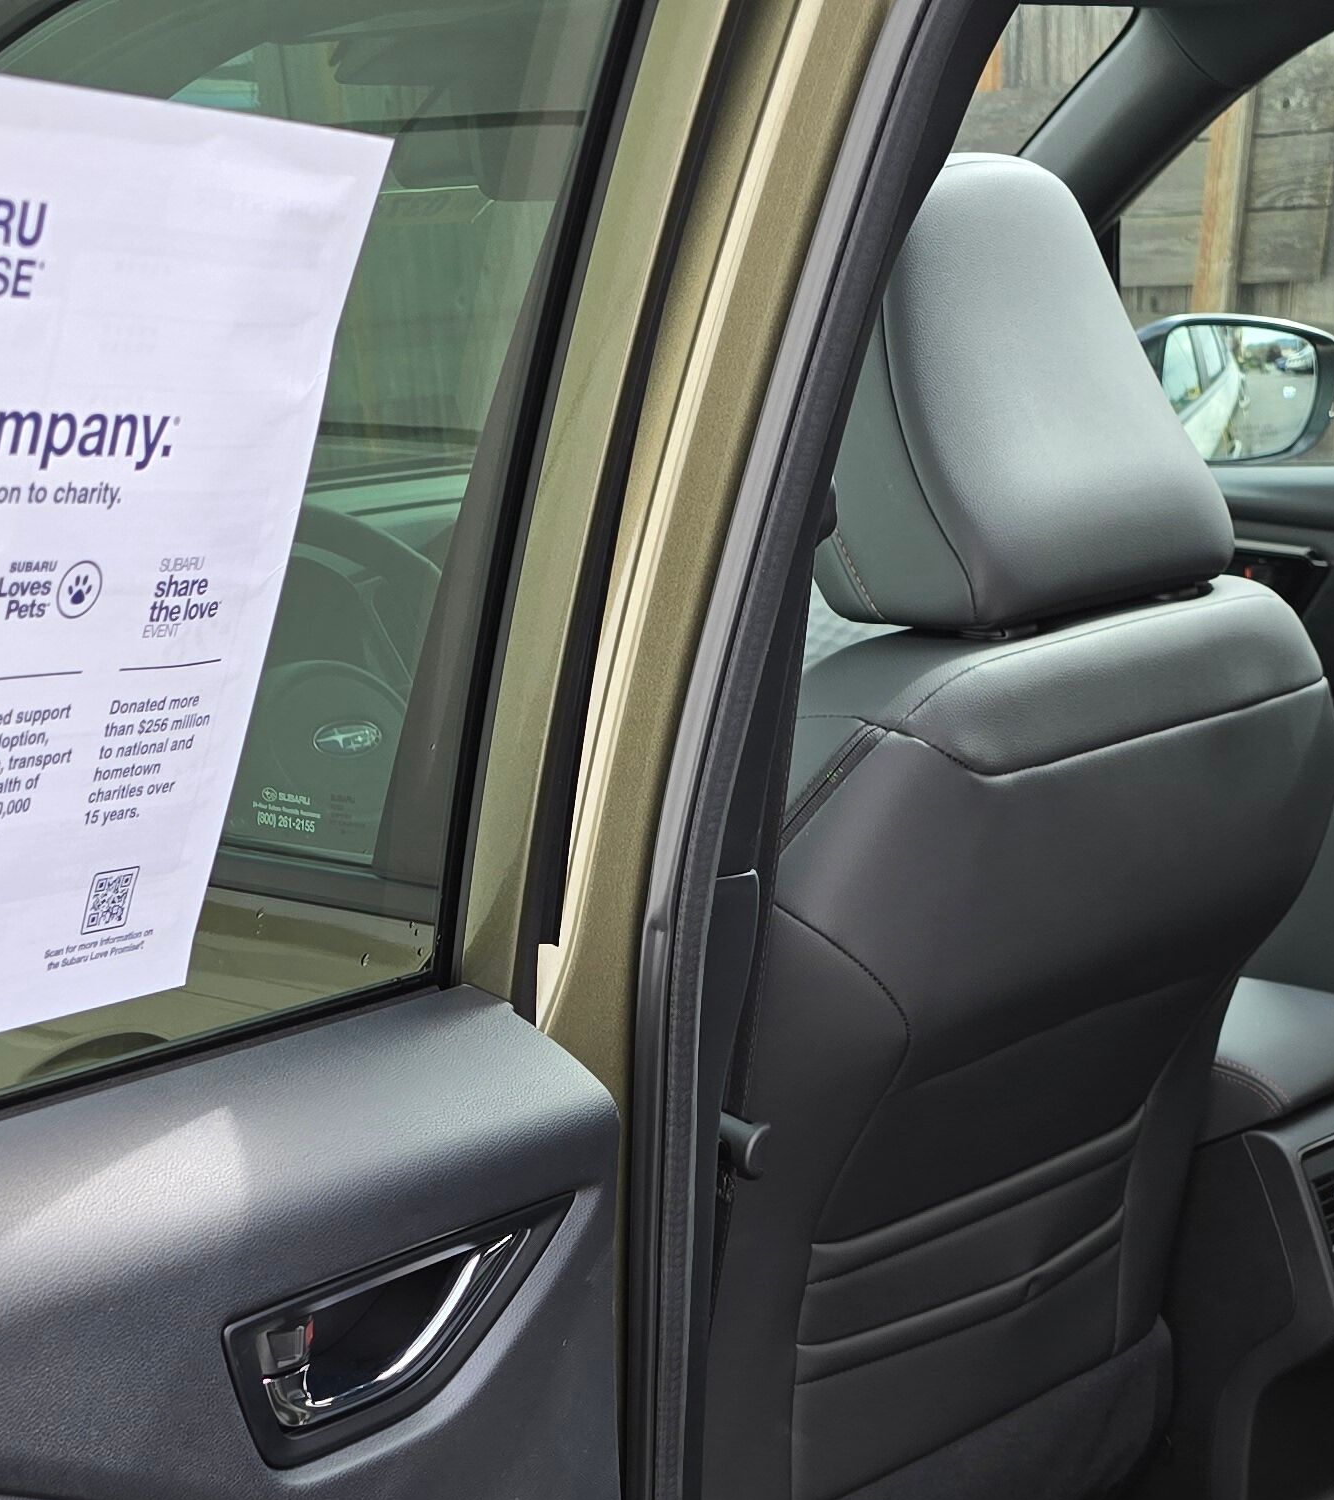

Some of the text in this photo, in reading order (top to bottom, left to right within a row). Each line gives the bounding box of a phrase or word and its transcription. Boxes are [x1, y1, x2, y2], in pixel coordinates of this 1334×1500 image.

[28, 482, 47, 505] to
[53, 481, 123, 510] charity.
[9, 560, 58, 574] SUBARU
[159, 557, 205, 573] SUBARU
[154, 574, 209, 598] share
[5, 600, 46, 620] Pets
[149, 598, 219, 623] the love
[142, 623, 181, 639] EVENT
[109, 693, 200, 715] Donated more
[15, 704, 72, 727] support
[104, 711, 211, 738] than $256 million
[99, 735, 195, 760] to national and
[8, 749, 73, 772] transport
[94, 761, 161, 782] hometown
[25, 773, 41, 791] of
[87, 780, 176, 805] charities over
[278, 791, 311, 806] SUBARU
[84, 804, 141, 826] 15 years.
[278, 815, 315, 833] 261-2155
[44, 929, 154, 959] Scan for more information on
[47, 959, 60, 971] the
[61, 954, 89, 968] Subaru
[90, 949, 109, 961] Love
